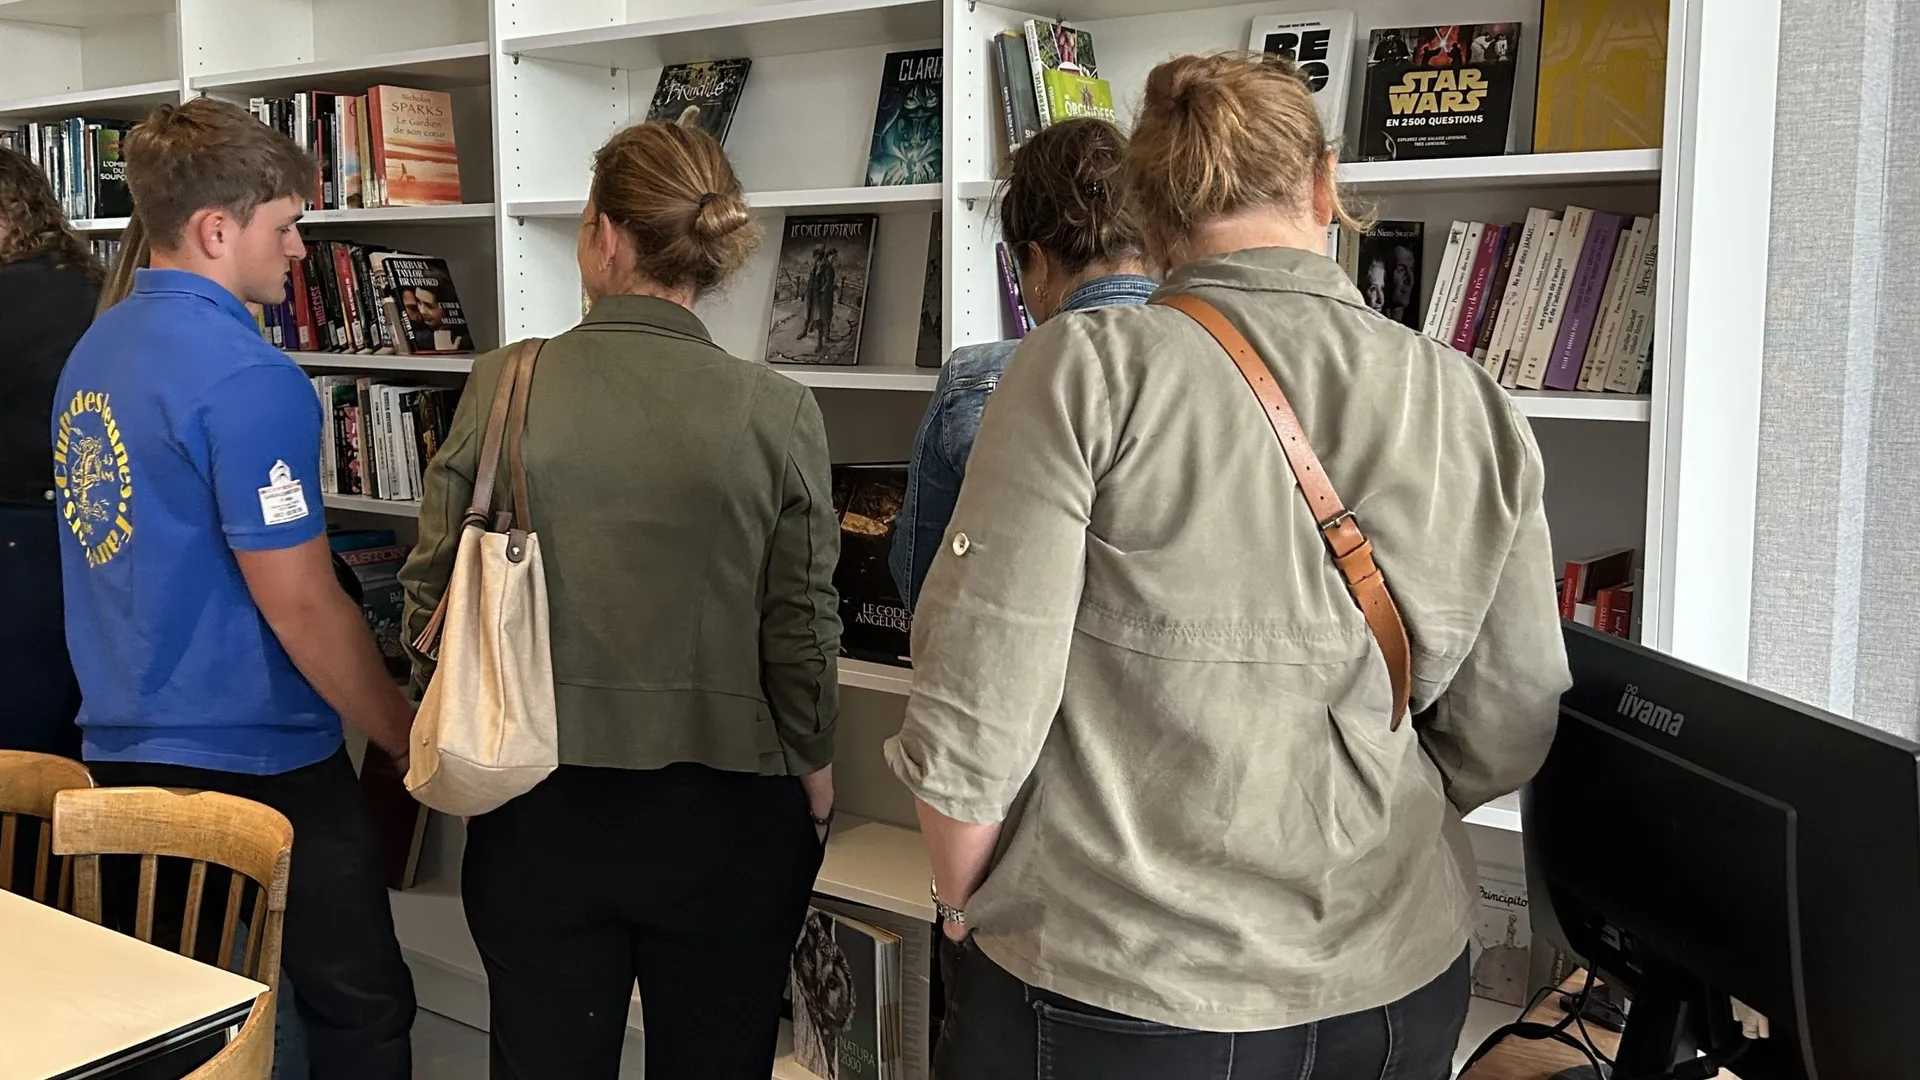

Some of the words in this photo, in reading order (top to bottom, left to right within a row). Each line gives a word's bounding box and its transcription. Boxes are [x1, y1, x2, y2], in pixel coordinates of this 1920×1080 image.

[1389, 69, 1488, 93] STAR
[391, 101, 444, 117] SPARKS
[1389, 90, 1487, 114] WARS
[396, 116, 406, 124] Le
[409, 117, 441, 128] Gardien
[1386, 118, 1400, 127] EN
[1401, 117, 1426, 127] 2500
[1428, 114, 1484, 126] QUESTIONS
[393, 125, 404, 134] de
[102, 160, 127, 168] L'OMB
[1517, 248, 1528, 264] dites
[393, 260, 428, 270] BARBARA
[1514, 264, 1524, 278] leur
[396, 269, 424, 278] TAYLOR
[399, 278, 438, 286] BRADFORD
[1541, 291, 1553, 318] rythmes
[1550, 257, 1563, 282] l'enfant
[310, 285, 326, 326] INDÉCISE
[70, 389, 104, 417] des
[863, 602, 875, 614] LE
[855, 611, 911, 632] ANGELIQU
[1617, 683, 1685, 738] iiyama
[840, 1035, 876, 1068] NATURA
[840, 1050, 862, 1073] 2000
